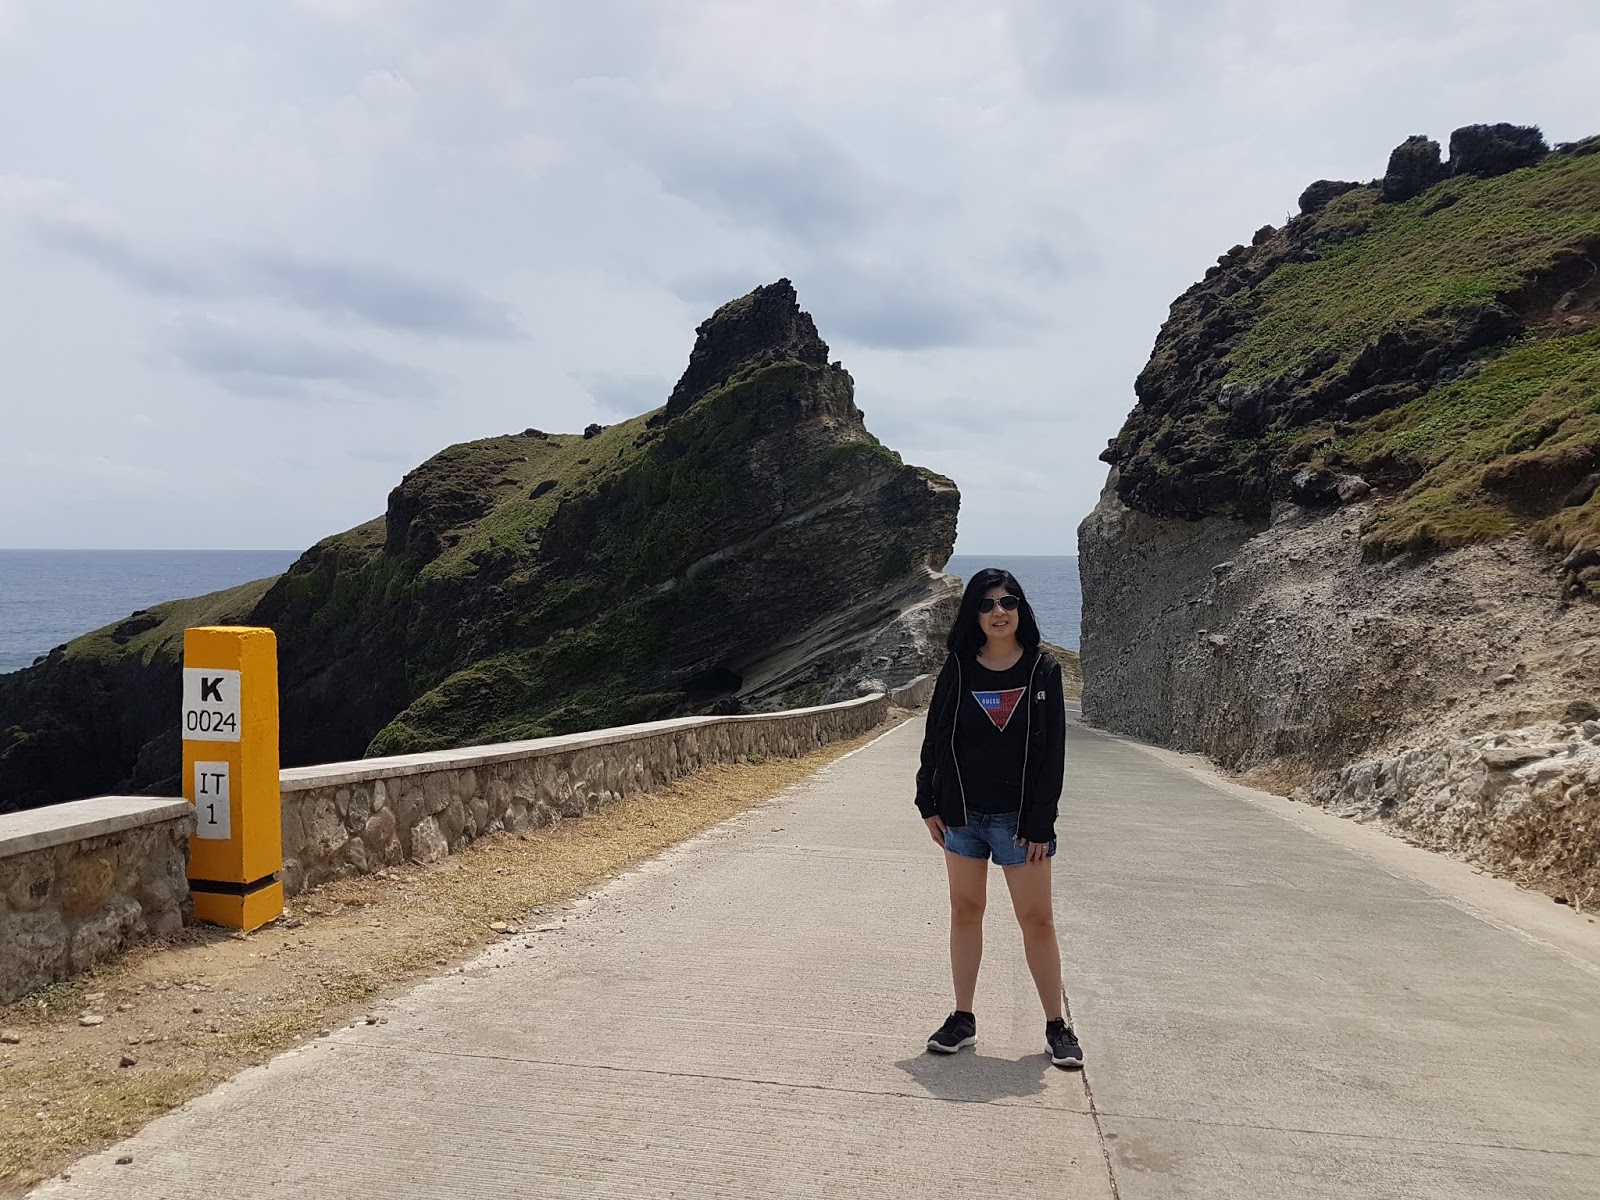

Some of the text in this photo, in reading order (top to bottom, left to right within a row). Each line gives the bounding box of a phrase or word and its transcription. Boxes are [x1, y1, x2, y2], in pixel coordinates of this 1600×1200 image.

[201, 677, 225, 702] K
[187, 710, 236, 732] 0024
[200, 773, 226, 795] IT
[206, 804, 218, 824] 1
